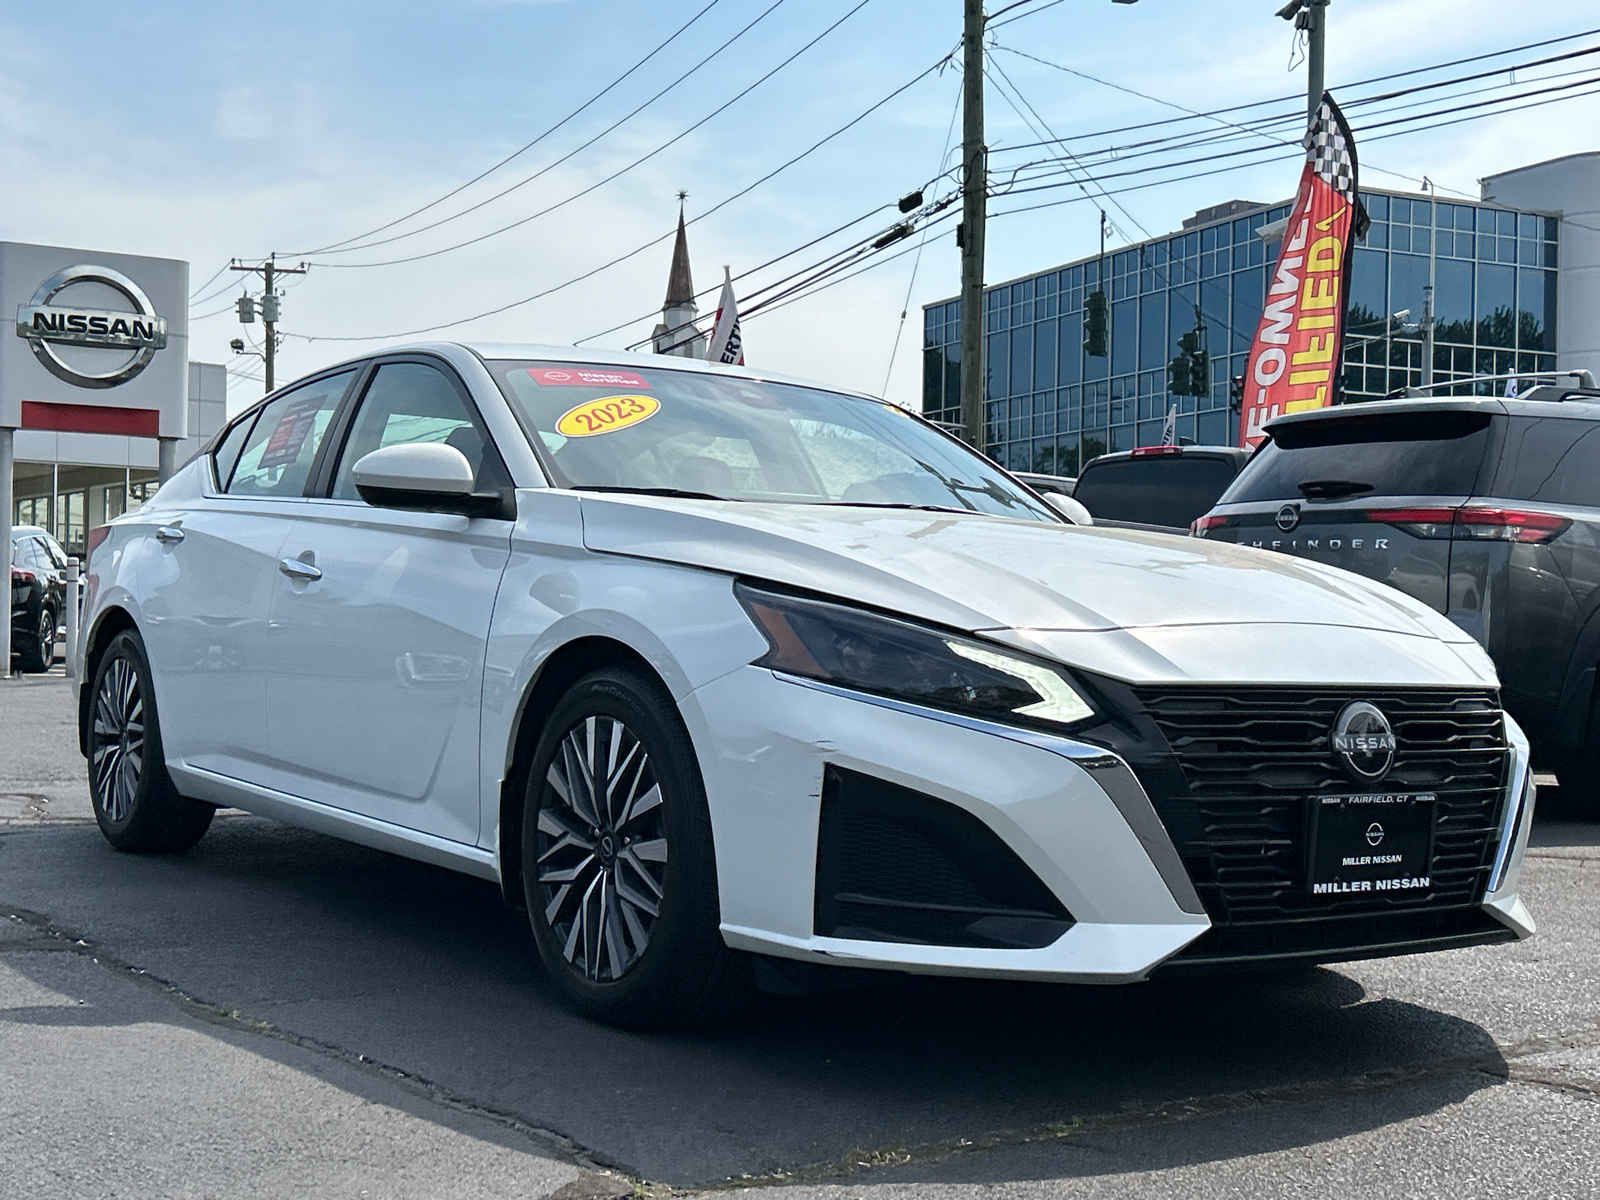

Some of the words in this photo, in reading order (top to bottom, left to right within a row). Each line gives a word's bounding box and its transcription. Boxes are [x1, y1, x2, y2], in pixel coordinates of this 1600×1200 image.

[33, 312, 153, 340] NISSAN
[578, 372, 623, 380] Nissan
[582, 377, 640, 385] Certified
[575, 398, 646, 431] 2023
[1236, 538, 1389, 550] HFINDER
[1335, 737, 1397, 749] NISSAN
[1396, 795, 1409, 803] CT
[1342, 856, 1371, 866] MILLER
[1372, 854, 1402, 864] NISSAN
[1313, 880, 1372, 894] MILLER
[1375, 877, 1430, 891] NISSAN
